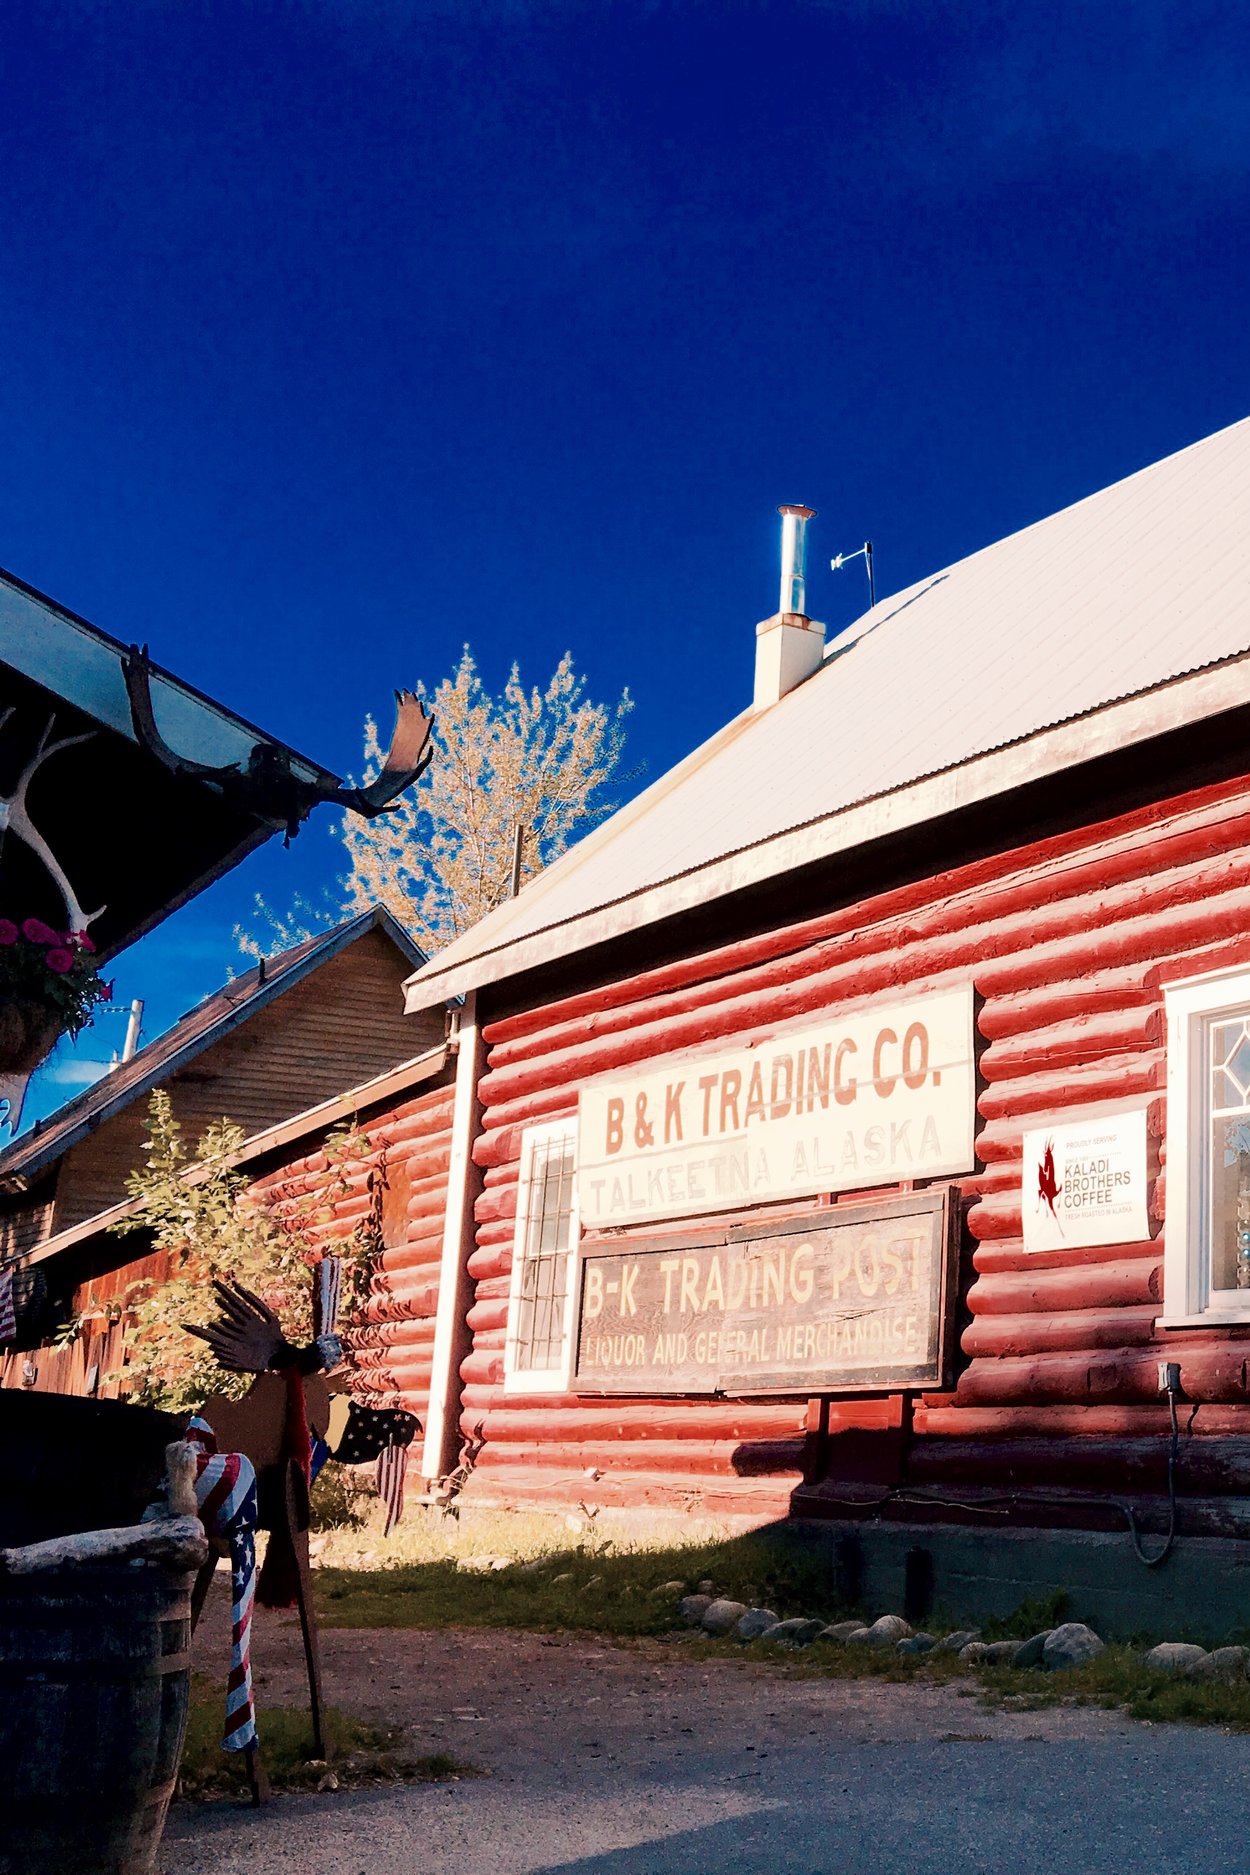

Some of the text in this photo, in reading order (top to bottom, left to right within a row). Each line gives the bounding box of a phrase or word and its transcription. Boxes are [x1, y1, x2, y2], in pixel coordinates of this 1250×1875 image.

[605, 1021, 942, 1155] B & K TRADING CO.
[1066, 1140, 1092, 1149] PROUDLY
[590, 1114, 943, 1217] TALKEETNA ALASKA
[1064, 1159, 1110, 1178] KALADI
[1064, 1171, 1132, 1194] BROTHERS
[1063, 1189, 1112, 1208] COFFEE
[1112, 1206, 1133, 1214] ALASKA
[584, 1229, 929, 1318] B-K TRADING POST
[586, 1334, 645, 1366] LIQUOR
[652, 1332, 691, 1365] AND
